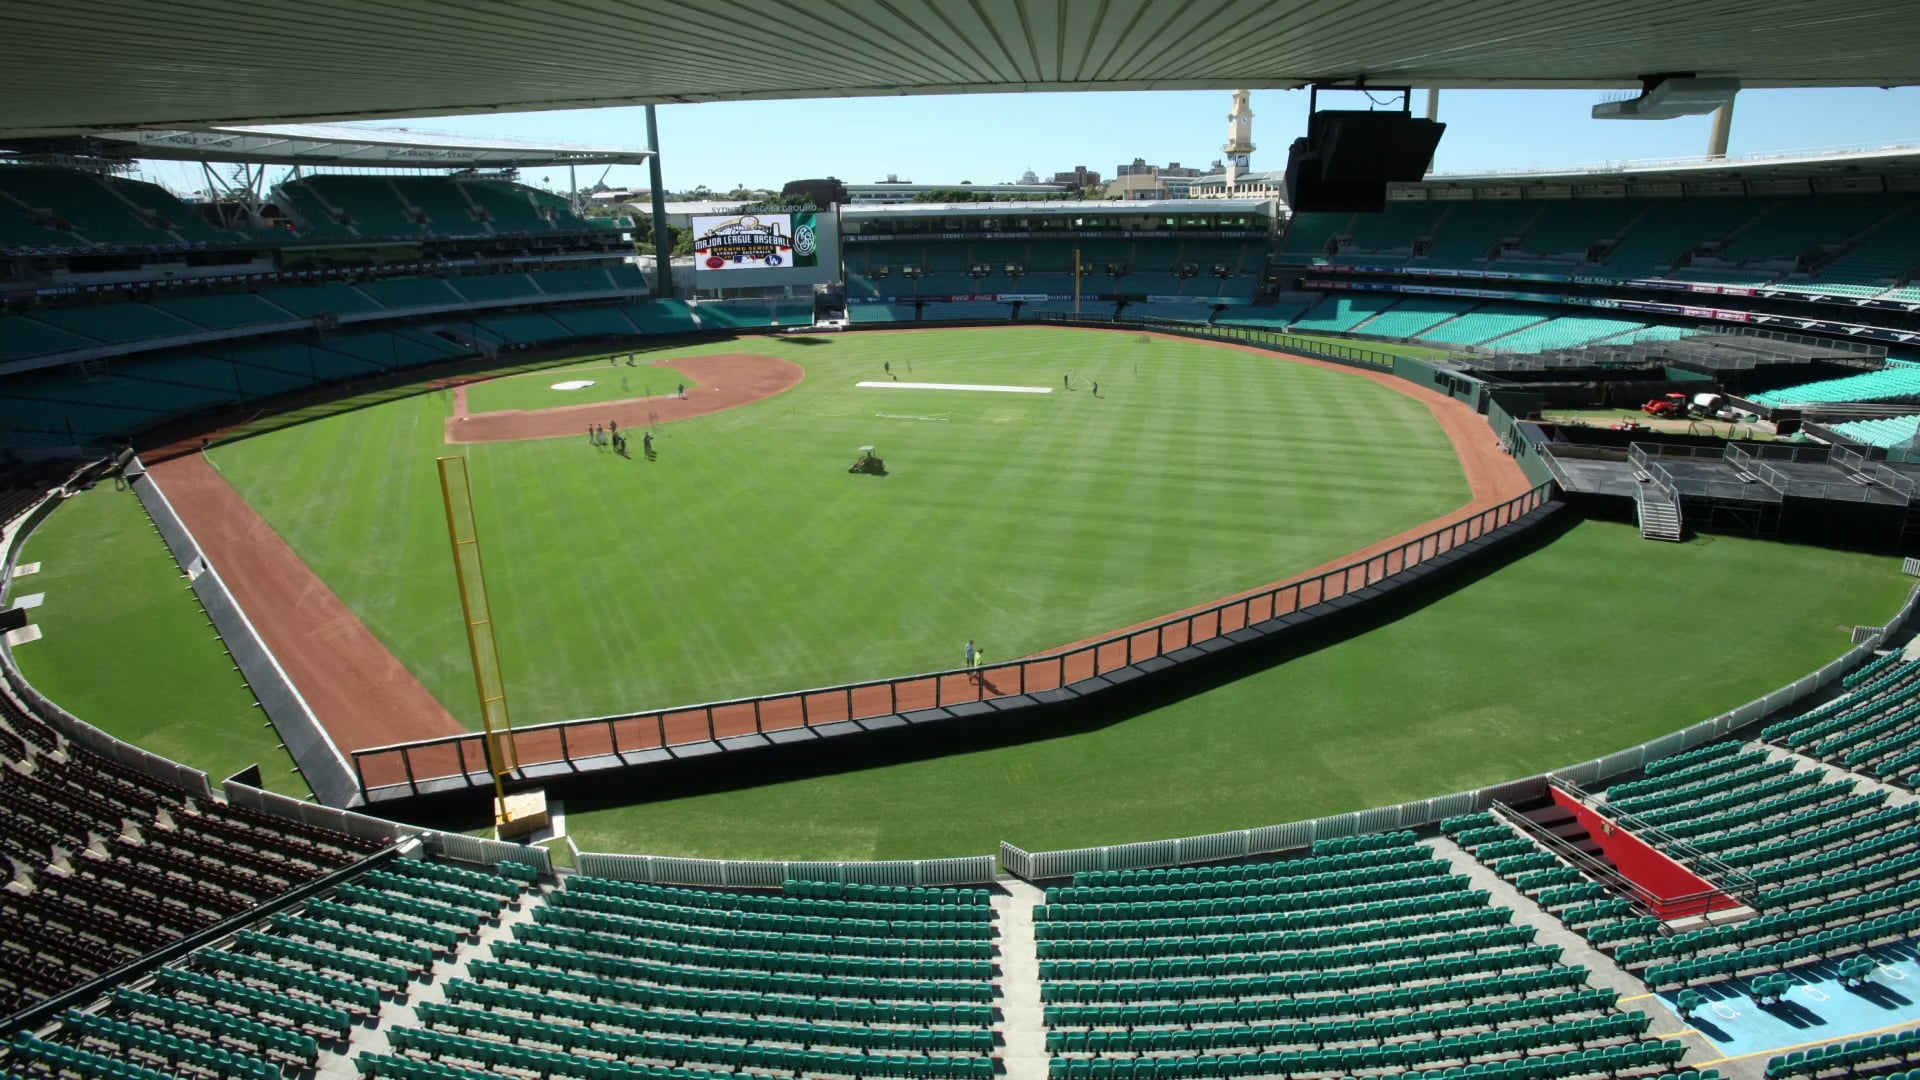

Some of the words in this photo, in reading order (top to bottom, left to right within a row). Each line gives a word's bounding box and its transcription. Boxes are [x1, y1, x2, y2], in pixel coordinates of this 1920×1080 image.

[783, 204, 817, 212] GROUND
[695, 237, 722, 250] MAJOR
[723, 235, 752, 245] LEAGUE
[754, 235, 791, 247] BASEBALL
